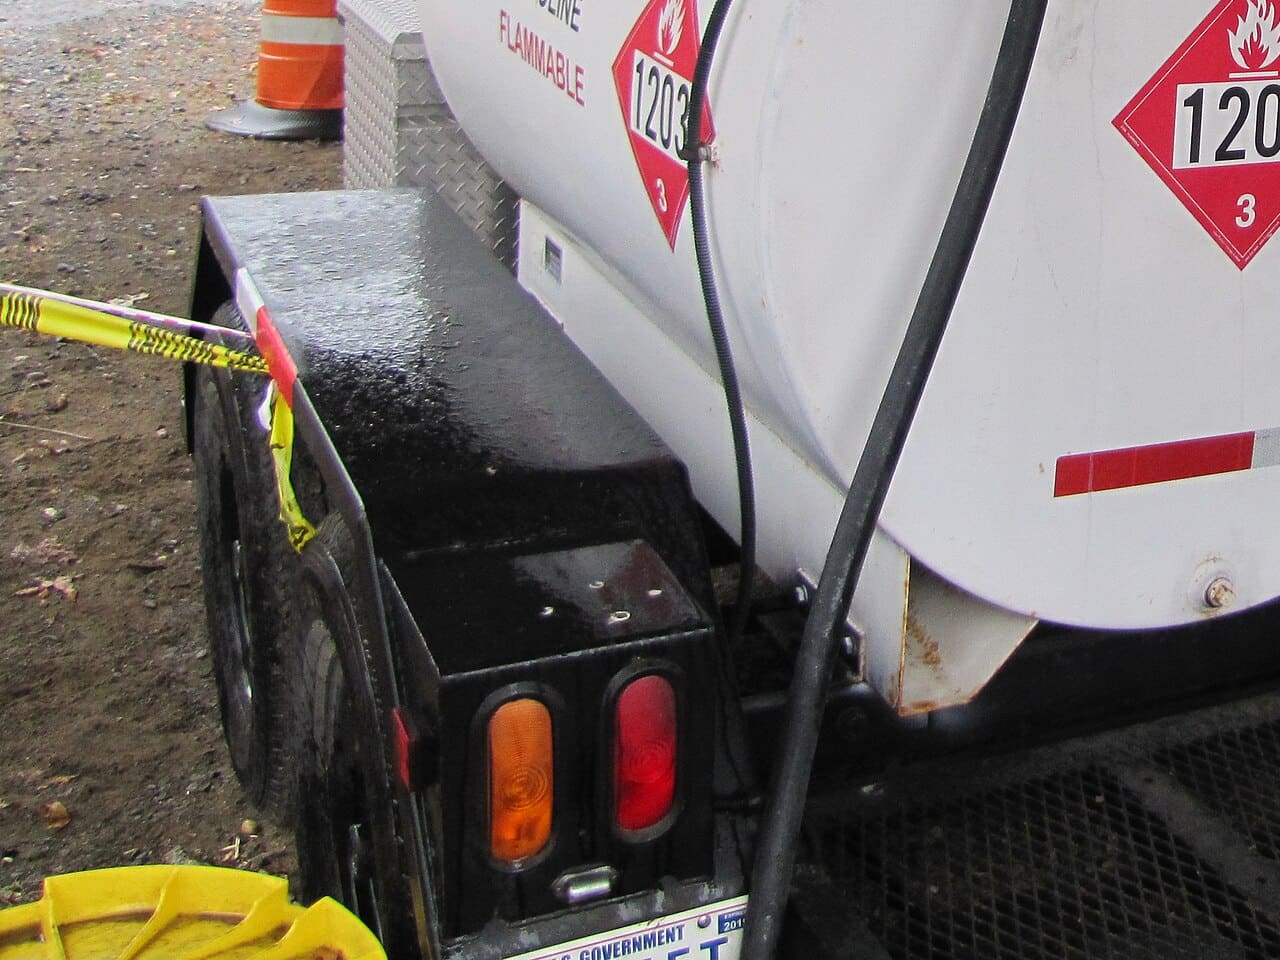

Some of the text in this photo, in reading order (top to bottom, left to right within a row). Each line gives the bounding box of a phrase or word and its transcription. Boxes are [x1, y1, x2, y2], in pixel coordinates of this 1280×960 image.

[500, 9, 585, 107] FLAMMABLE
[636, 58, 691, 161] 1203
[657, 178, 668, 213] 3
[1235, 193, 1256, 228] 3
[579, 924, 686, 960] GOVERNMENT
